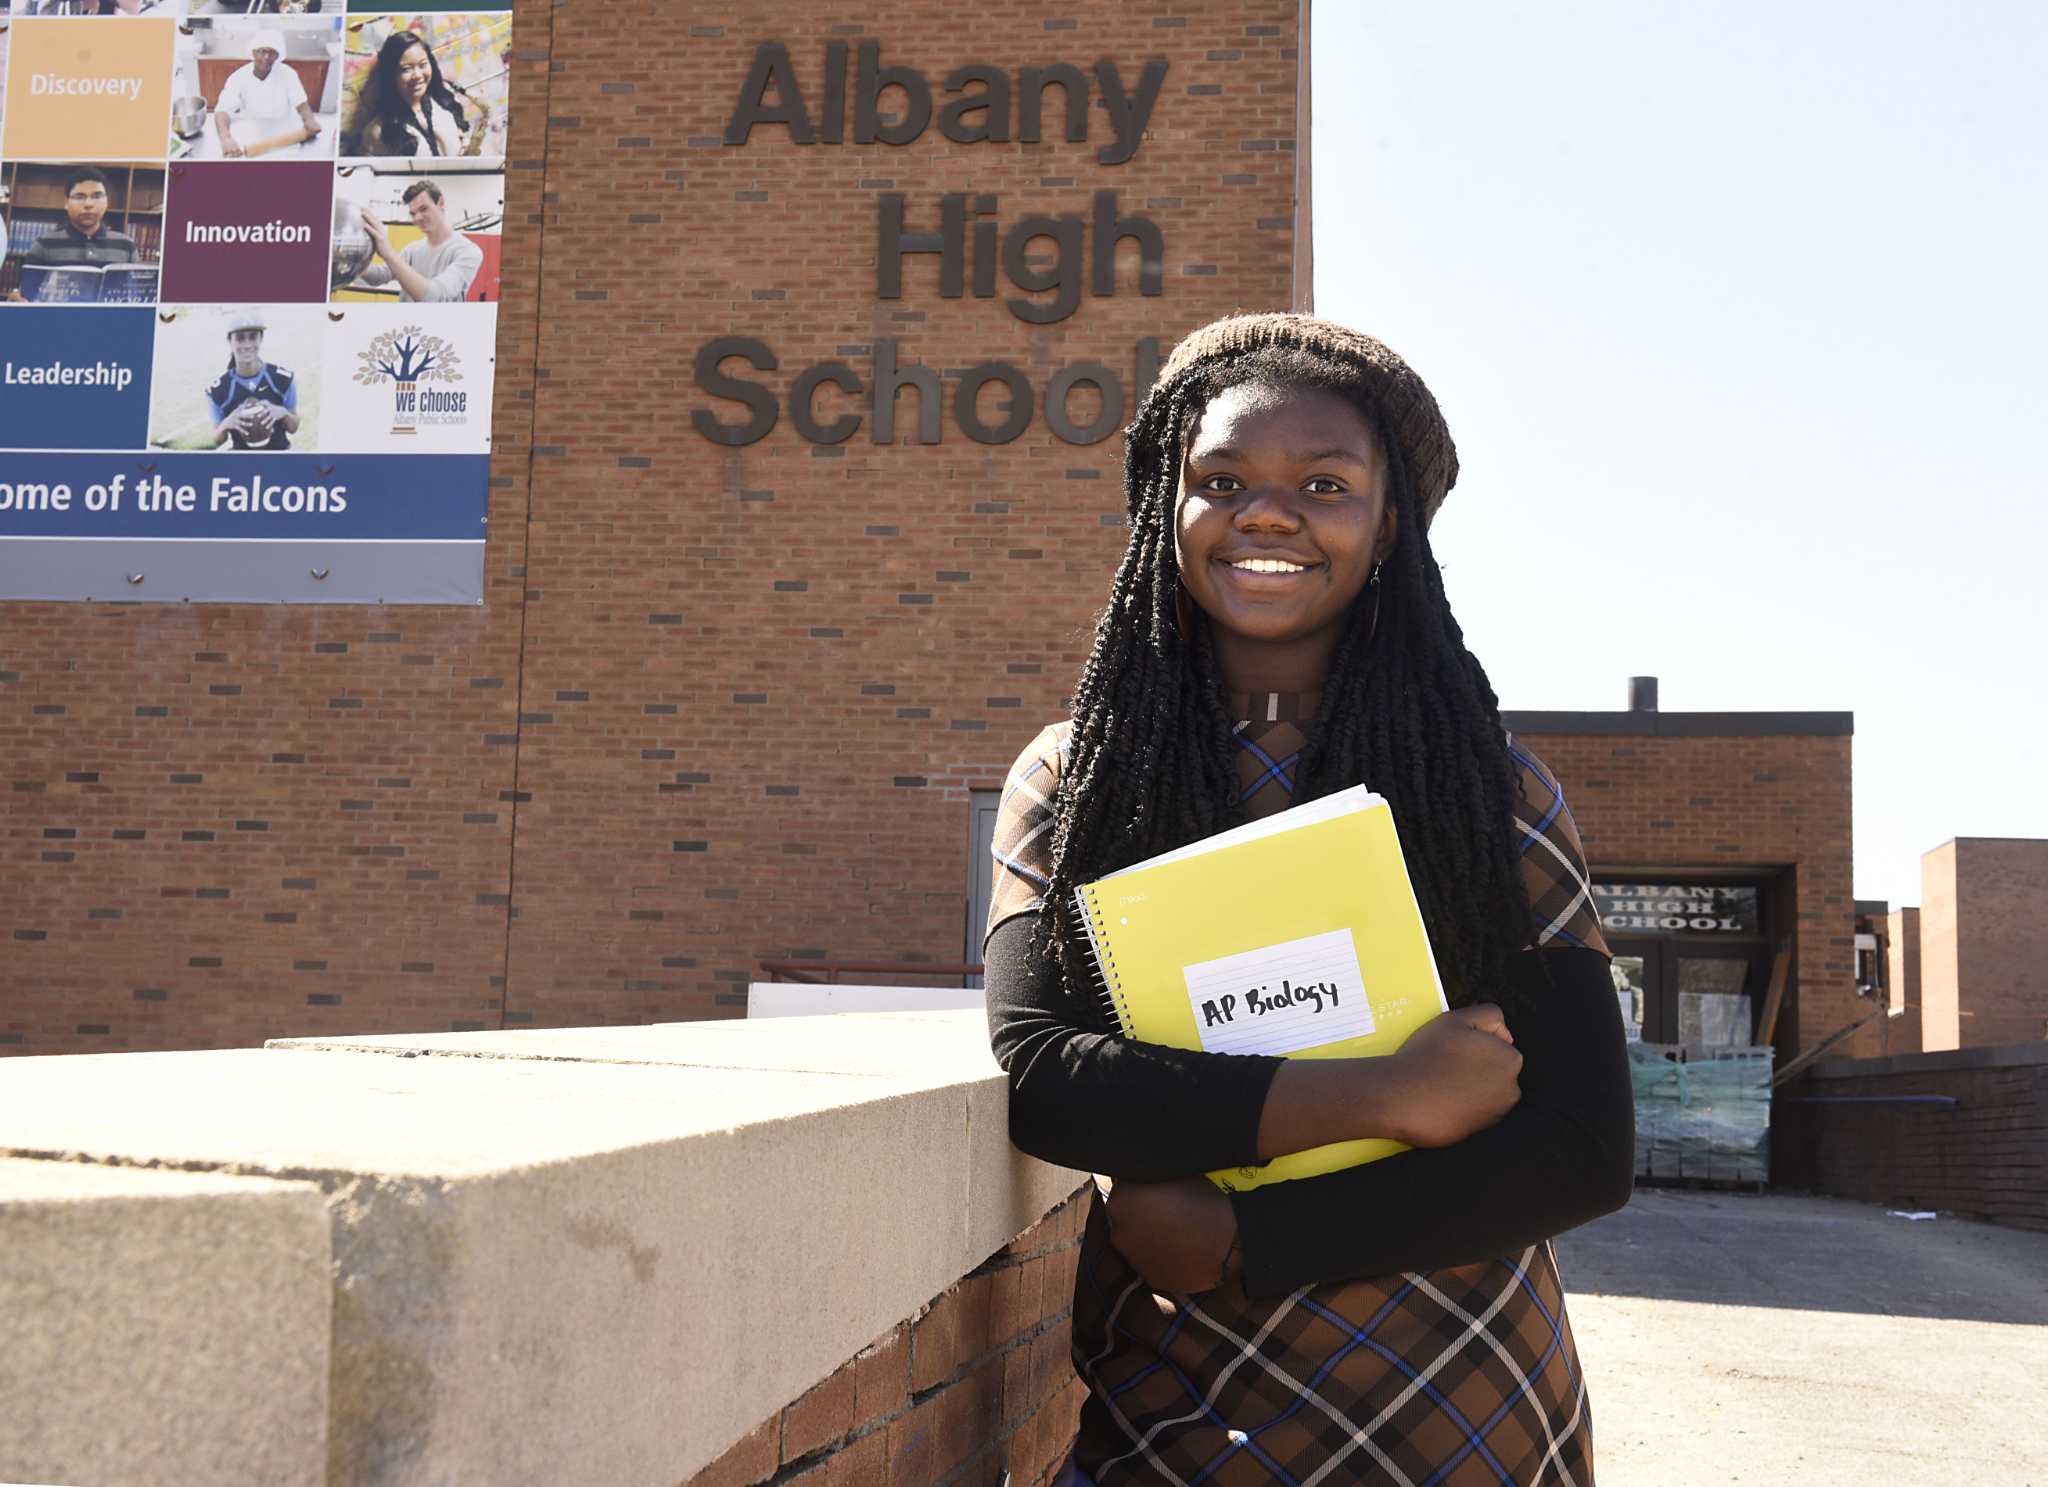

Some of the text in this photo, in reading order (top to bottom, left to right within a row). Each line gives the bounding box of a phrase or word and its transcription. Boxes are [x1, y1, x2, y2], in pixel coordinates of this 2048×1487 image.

[31, 74, 143, 100] Discovery
[723, 41, 1169, 165] Albany
[185, 220, 312, 246] Innovation
[877, 190, 1164, 324] High
[5, 361, 132, 391] Leadership
[395, 387, 466, 412] we choose
[0, 474, 347, 512] ome of the Falcons
[1590, 885, 1740, 900] ALBANY
[1611, 900, 1715, 914] HIGH
[1602, 915, 1742, 931] CHOOL
[1201, 980, 1339, 1027] AP Biology
